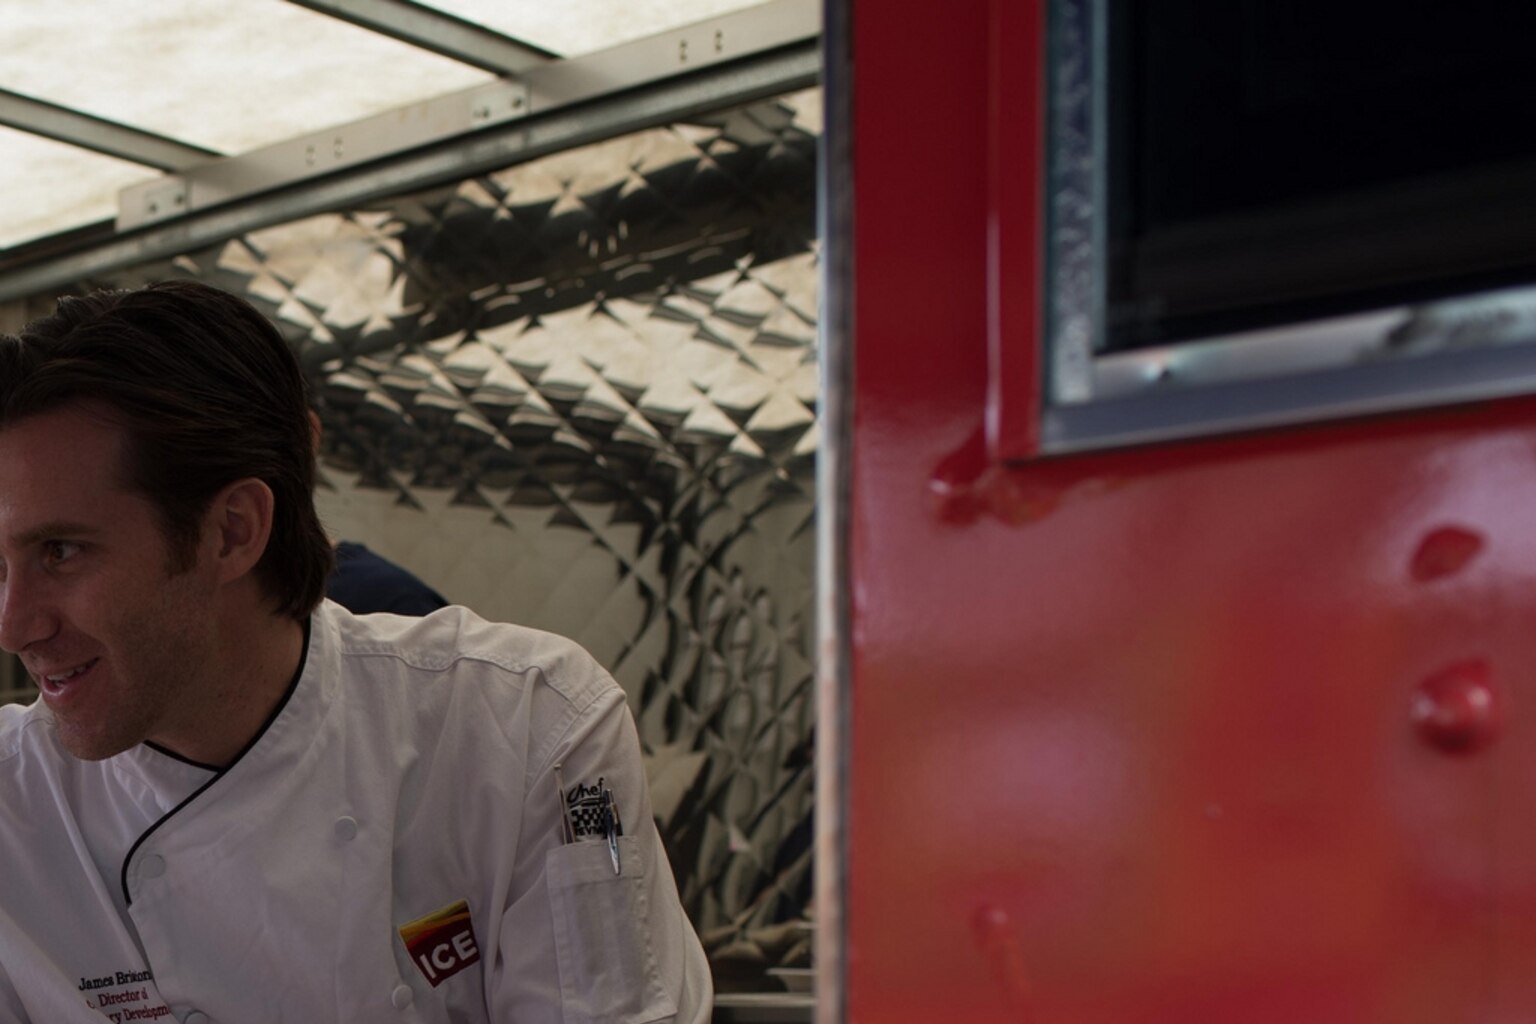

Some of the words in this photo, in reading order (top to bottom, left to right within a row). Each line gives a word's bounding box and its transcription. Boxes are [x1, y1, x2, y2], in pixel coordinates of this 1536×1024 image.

[567, 777, 604, 803] Chef
[419, 929, 478, 980] ICE
[79, 977, 114, 991] James
[97, 989, 140, 1007] Director
[123, 1004, 171, 1021] Developm
